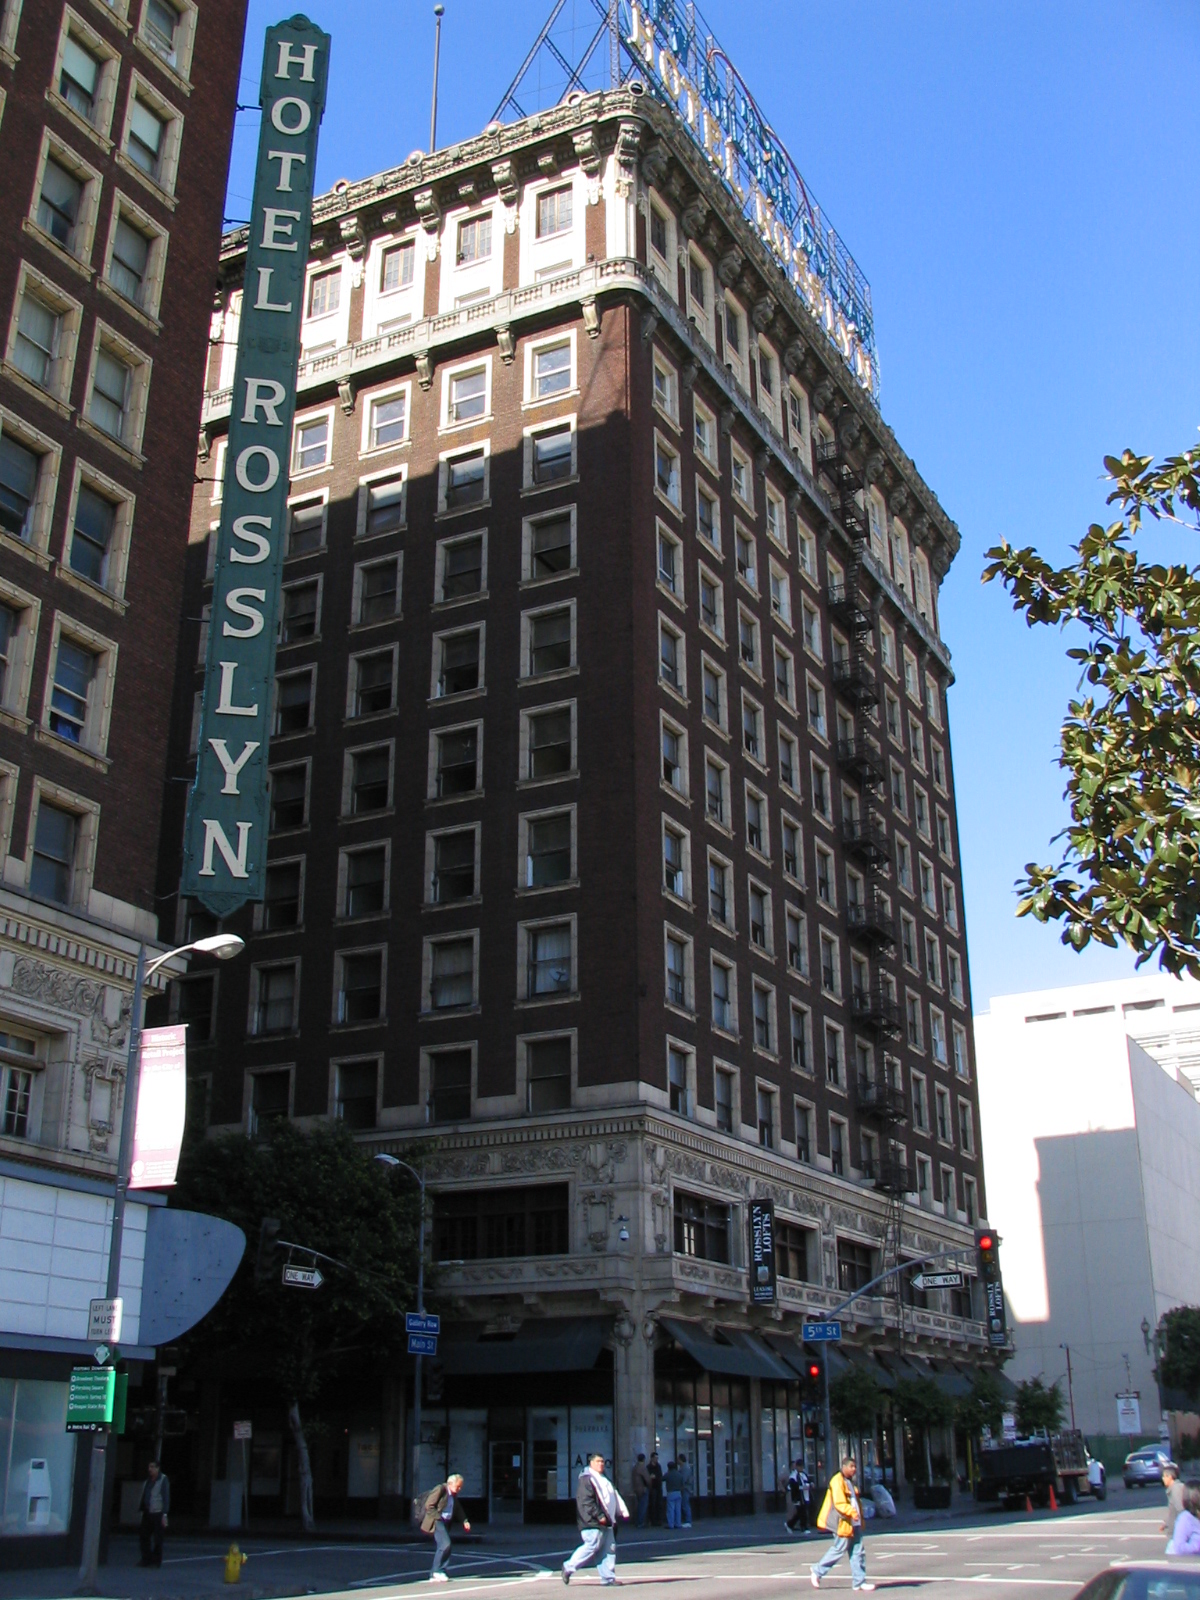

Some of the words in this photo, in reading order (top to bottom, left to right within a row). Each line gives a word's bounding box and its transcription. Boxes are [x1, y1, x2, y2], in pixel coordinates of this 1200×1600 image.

[254, 41, 318, 312] HOTEL
[627, 0, 745, 204] HOTEL
[754, 185, 874, 392] ROSSLYN
[198, 377, 286, 878] ROSSLYN
[752, 1206, 763, 1262] ROSSLYN
[762, 1213, 772, 1253] LOFTS
[286, 1270, 299, 1281] ONE
[302, 1272, 314, 1282] WAY
[922, 1274, 937, 1285] ONE
[942, 1274, 959, 1284] WAY
[987, 1282, 996, 1316] ROSSLY
[93, 1315, 116, 1324] MUST
[408, 1318, 426, 1328] Gallery
[427, 1320, 437, 1328] Row
[808, 1326, 823, 1338] 5th
[826, 1326, 837, 1336] St
[411, 1338, 425, 1348] Main
[427, 1340, 434, 1350] St
